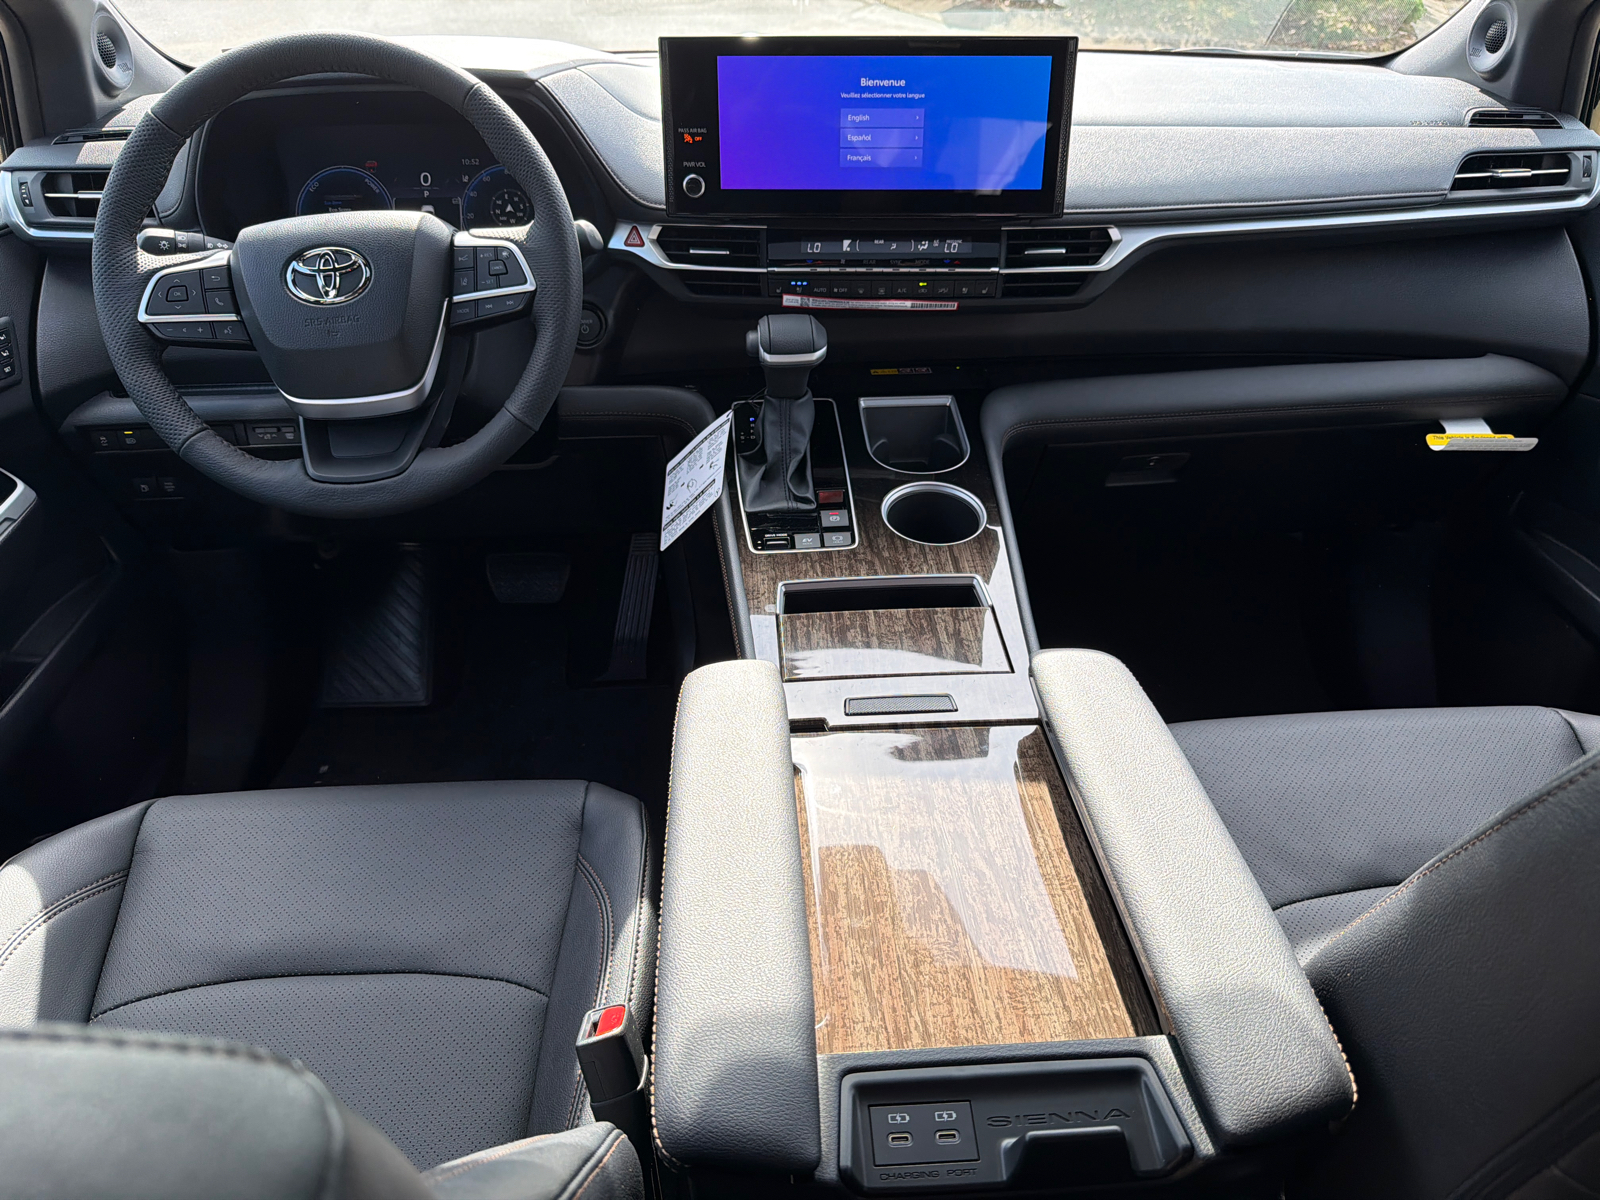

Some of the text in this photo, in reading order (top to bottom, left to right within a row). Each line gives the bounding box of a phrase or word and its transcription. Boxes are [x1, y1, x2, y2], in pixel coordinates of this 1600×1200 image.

[860, 77, 906, 87] Bienvenue
[847, 114, 870, 122] English
[847, 134, 872, 142] Español
[847, 154, 872, 162] Français
[420, 172, 432, 186] 0
[309, 181, 320, 192] ECO
[304, 314, 360, 327] SRS AIRBAG
[986, 1108, 1132, 1128] SIENNA
[880, 1168, 979, 1181] CHARGING PORT
